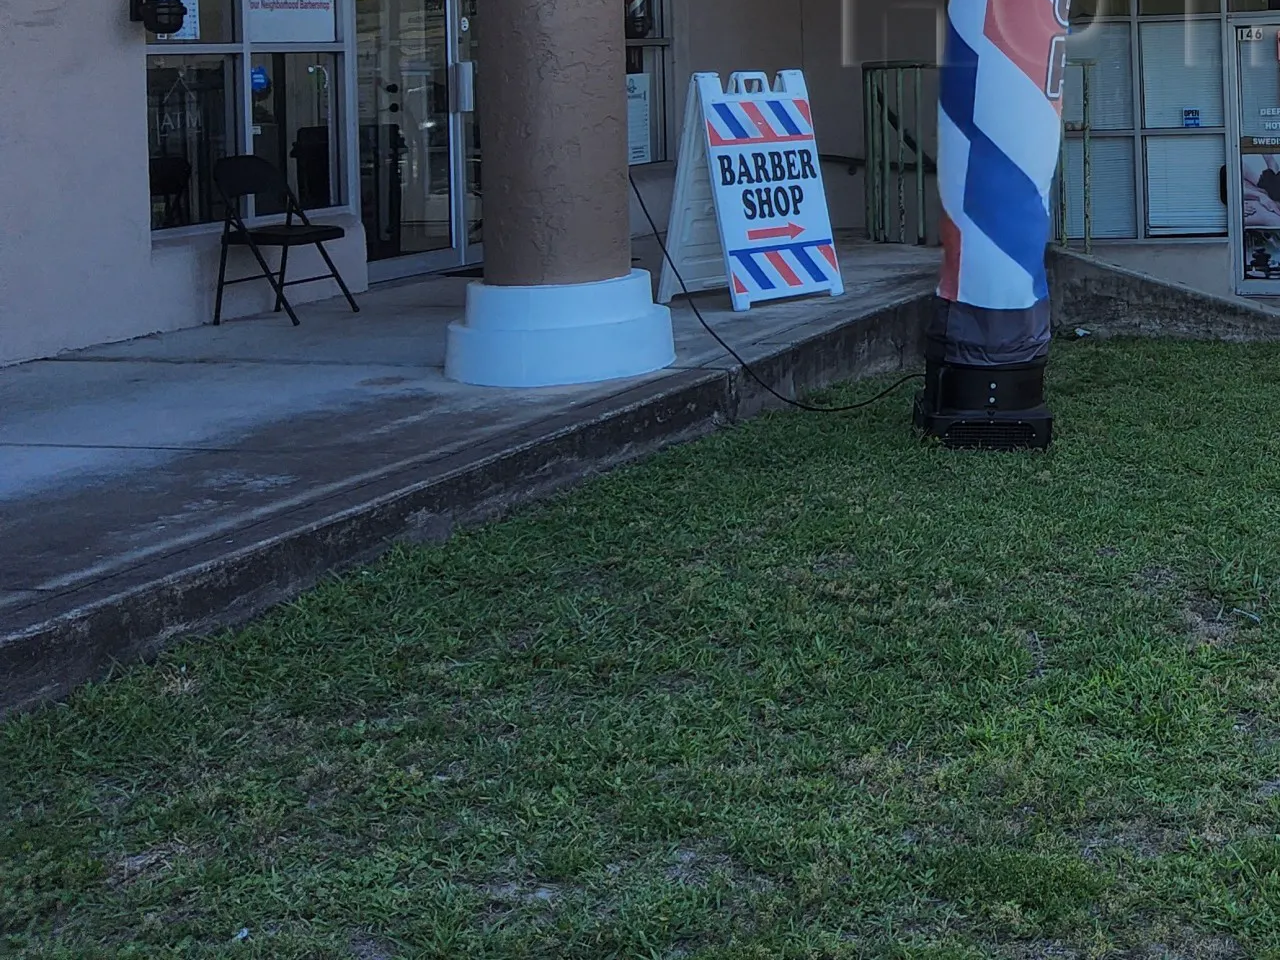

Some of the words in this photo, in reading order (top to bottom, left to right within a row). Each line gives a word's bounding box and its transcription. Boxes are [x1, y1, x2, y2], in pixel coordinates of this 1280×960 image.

[1240, 29, 1262, 40] 146
[161, 111, 201, 131] ATM
[717, 149, 817, 186] BARBER
[742, 185, 804, 220] SHOP
